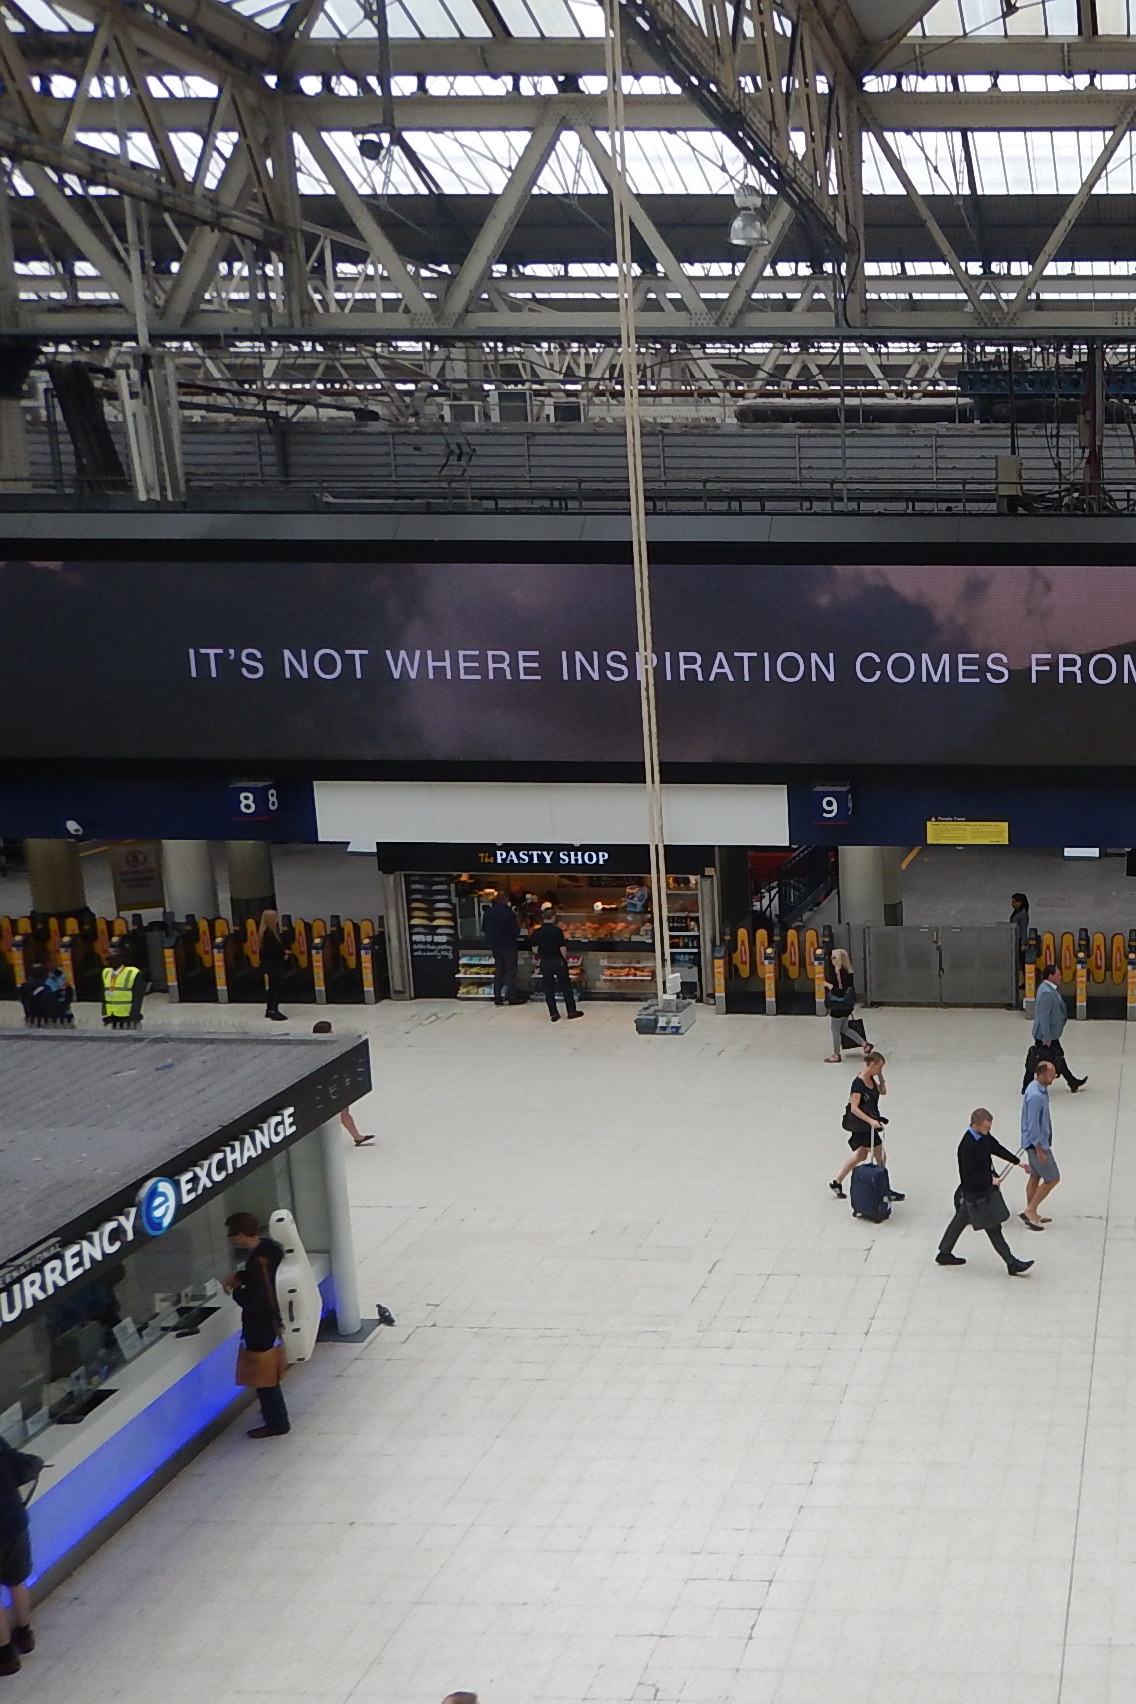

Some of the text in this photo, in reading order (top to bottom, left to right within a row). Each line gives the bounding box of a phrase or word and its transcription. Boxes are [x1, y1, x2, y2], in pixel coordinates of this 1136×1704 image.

[187, 648, 264, 680] IT'S
[283, 648, 368, 680] NOT
[385, 649, 542, 681] WHERE
[561, 650, 836, 682] INSPIRATION
[855, 651, 1010, 684] COMES
[239, 791, 256, 813] 8
[268, 788, 279, 811] 8
[822, 796, 838, 818] 9
[495, 850, 554, 864] PASTY
[559, 850, 609, 865] SHOP
[0, 1206, 138, 1327] URRENCY
[178, 1106, 297, 1206] EXCHANGE
